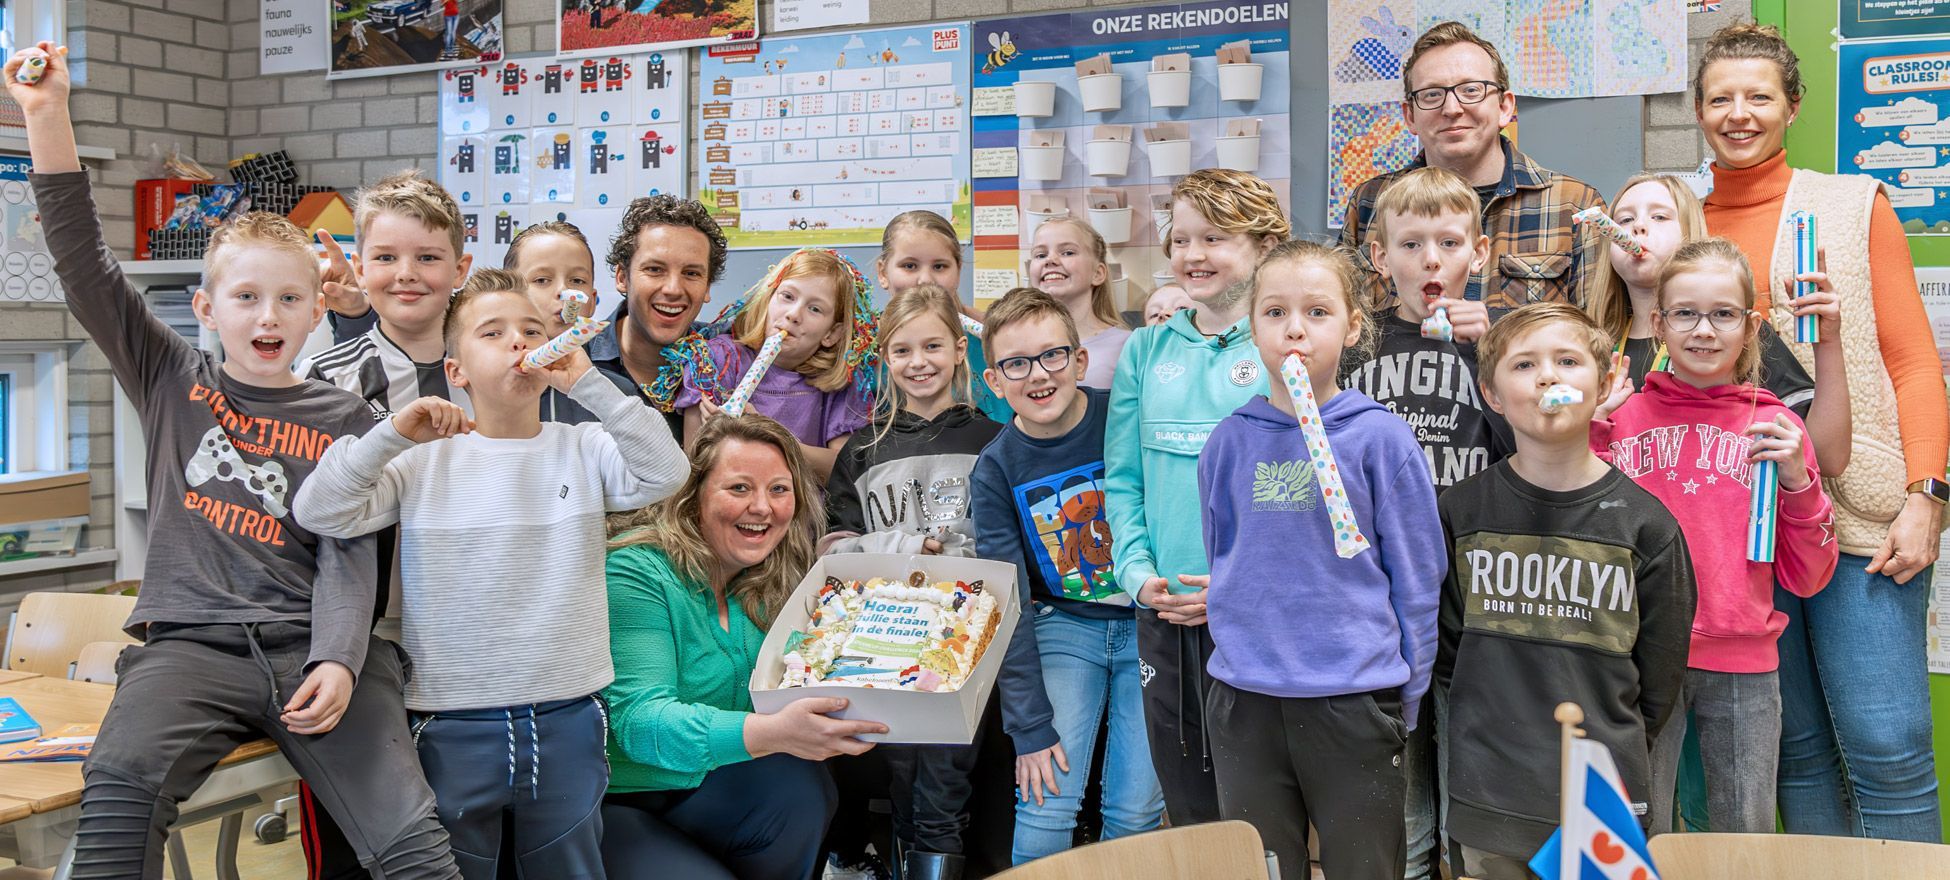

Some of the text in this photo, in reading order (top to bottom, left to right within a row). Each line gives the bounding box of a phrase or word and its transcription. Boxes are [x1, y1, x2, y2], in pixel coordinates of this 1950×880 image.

[265, 9, 292, 20] fauna
[1092, 2, 1289, 35] ONZE REKENDOELEN
[265, 24, 313, 38] nauwelijks
[934, 29, 958, 40] PLUS
[711, 43, 758, 53] REKENMUUR
[935, 39, 958, 49] PUNT
[265, 45, 293, 59] pauze
[1892, 72, 1939, 85] RULES!
[0, 163, 34, 176] po: D
[1920, 282, 1950, 297] AFFIR
[1344, 351, 1483, 411] INGIN
[1155, 431, 1184, 440] BLACK
[1418, 427, 1450, 443] Denim
[232, 437, 274, 457] UNDER
[1609, 424, 1688, 478] NEW
[1696, 423, 1754, 489] YOR
[1423, 445, 1489, 486] ANO
[868, 476, 972, 532] NAS
[184, 491, 286, 547] CONTROL
[1466, 549, 1636, 612] ROOKLYN
[863, 600, 919, 614] Hoera!
[1483, 599, 1593, 622] BORN TO BE REAL!
[892, 616, 929, 626] staan
[852, 625, 929, 638] in de finale!
